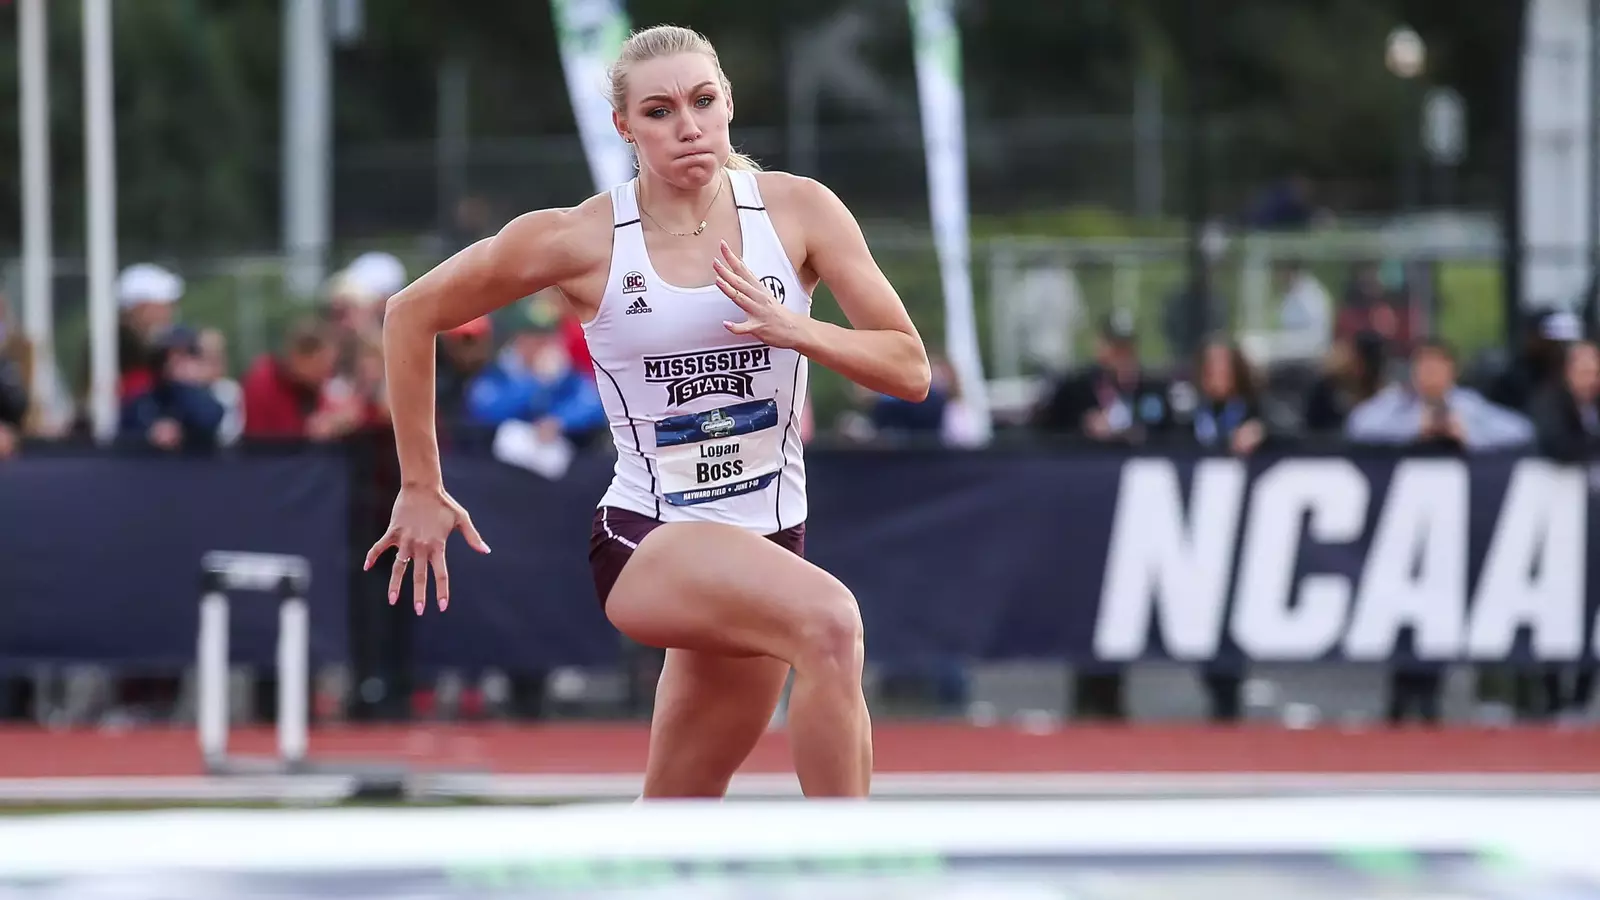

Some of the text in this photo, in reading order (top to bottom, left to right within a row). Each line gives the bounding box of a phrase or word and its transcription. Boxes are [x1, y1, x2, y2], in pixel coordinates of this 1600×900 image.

[626, 275, 643, 288] BC
[625, 307, 652, 315] adidas
[644, 348, 771, 378] MISSISSIPPI
[682, 377, 738, 399] STATE
[700, 443, 740, 458] Logan
[683, 490, 711, 501] HAYWARD
[711, 487, 727, 497] FIELD
[734, 482, 748, 492] JUNE
[1094, 456, 1586, 661] NCAA
